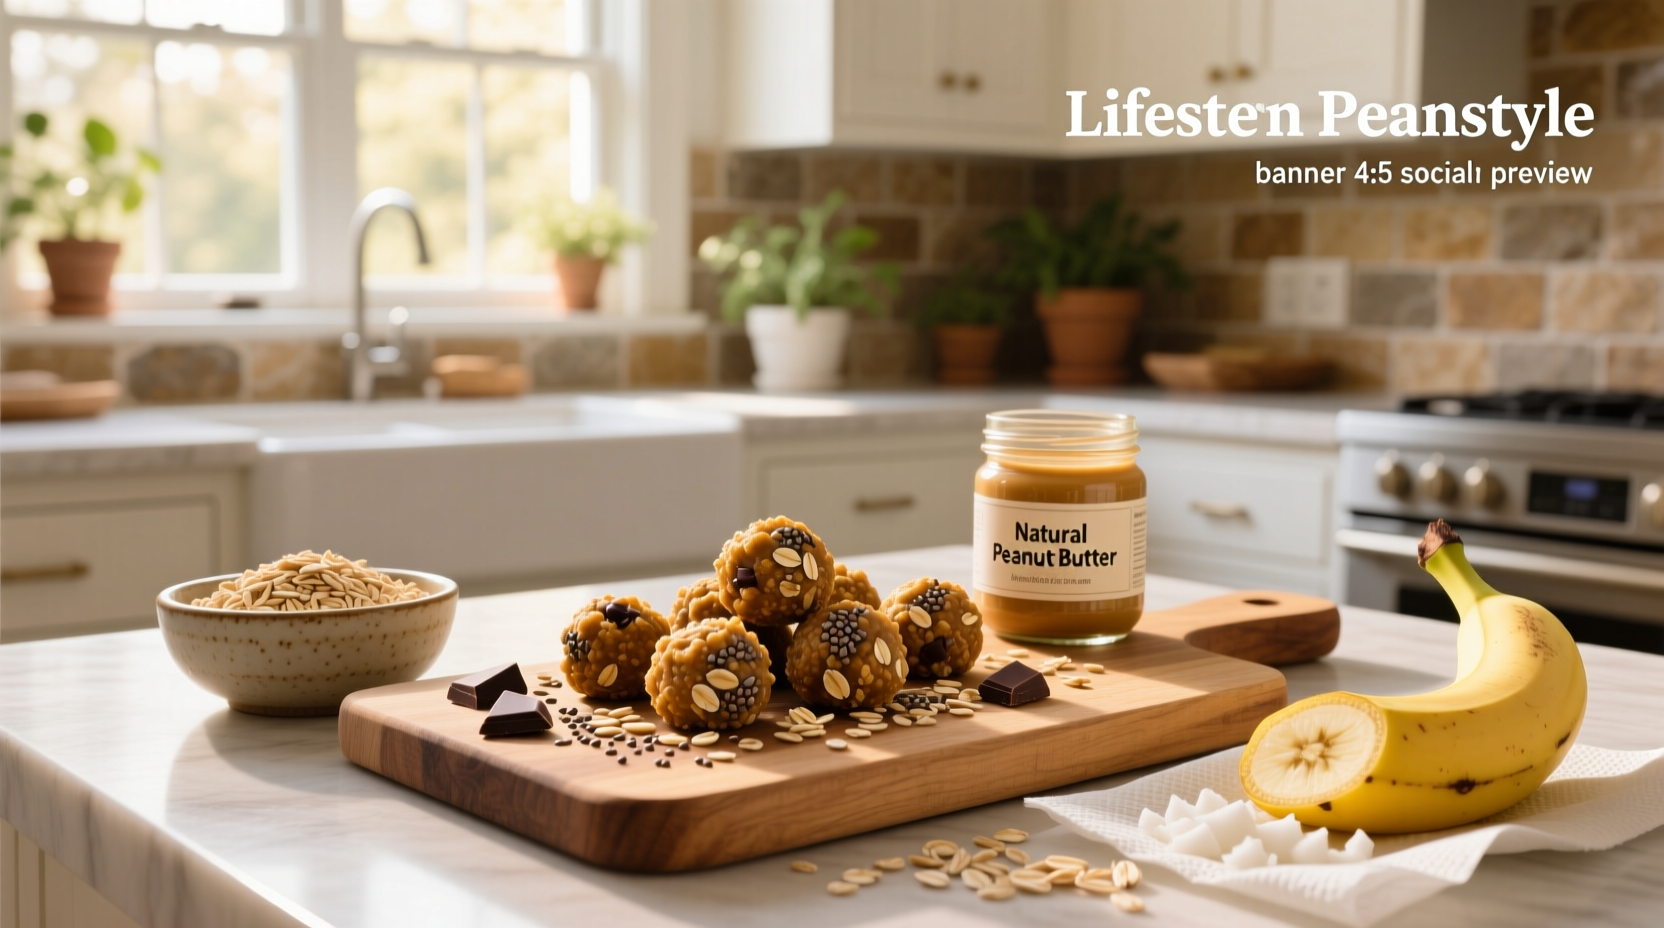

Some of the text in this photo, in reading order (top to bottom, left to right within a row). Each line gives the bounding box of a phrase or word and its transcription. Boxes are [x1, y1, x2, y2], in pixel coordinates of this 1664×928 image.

[1015, 521, 1087, 543] Natural
[993, 542, 1117, 567] Peanut Butter
